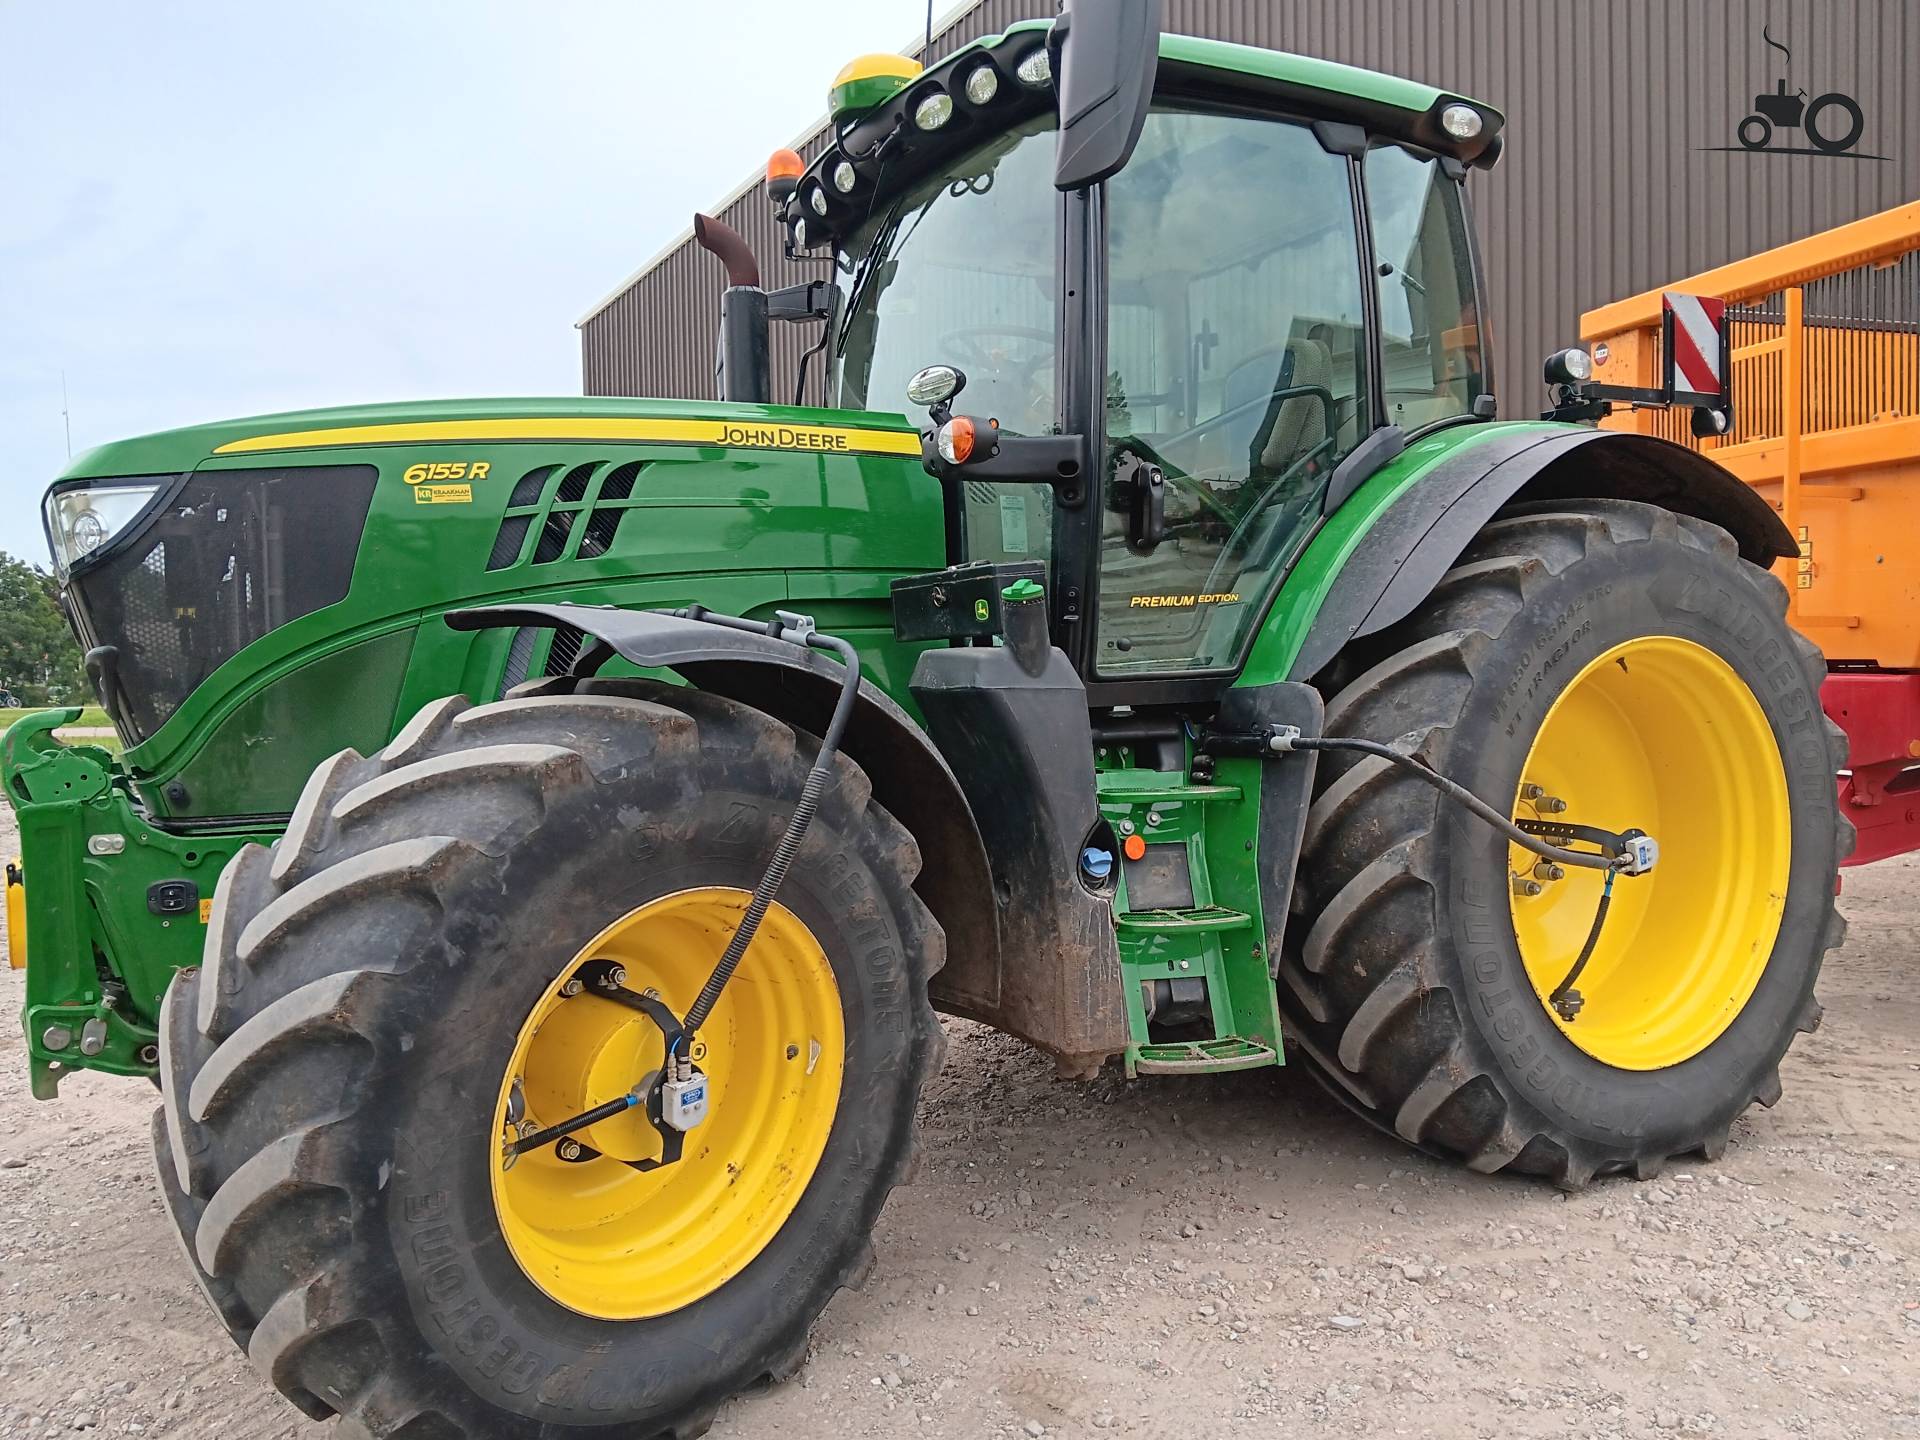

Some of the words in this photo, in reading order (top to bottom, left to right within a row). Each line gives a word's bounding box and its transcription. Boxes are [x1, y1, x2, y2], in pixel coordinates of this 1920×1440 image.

[403, 463, 468, 485] 6155
[467, 462, 490, 480] R
[716, 425, 775, 444] JOHN
[778, 428, 848, 449] DEERE
[1130, 595, 1195, 608] PREMIUM
[1197, 593, 1239, 603] EDITION
[1674, 572, 1829, 830] BRIDGESTONE
[711, 800, 905, 1034] BGESTONE
[1460, 877, 1650, 1138] BRIDGESTONE
[404, 1190, 674, 1412] BRIDGESTONE
